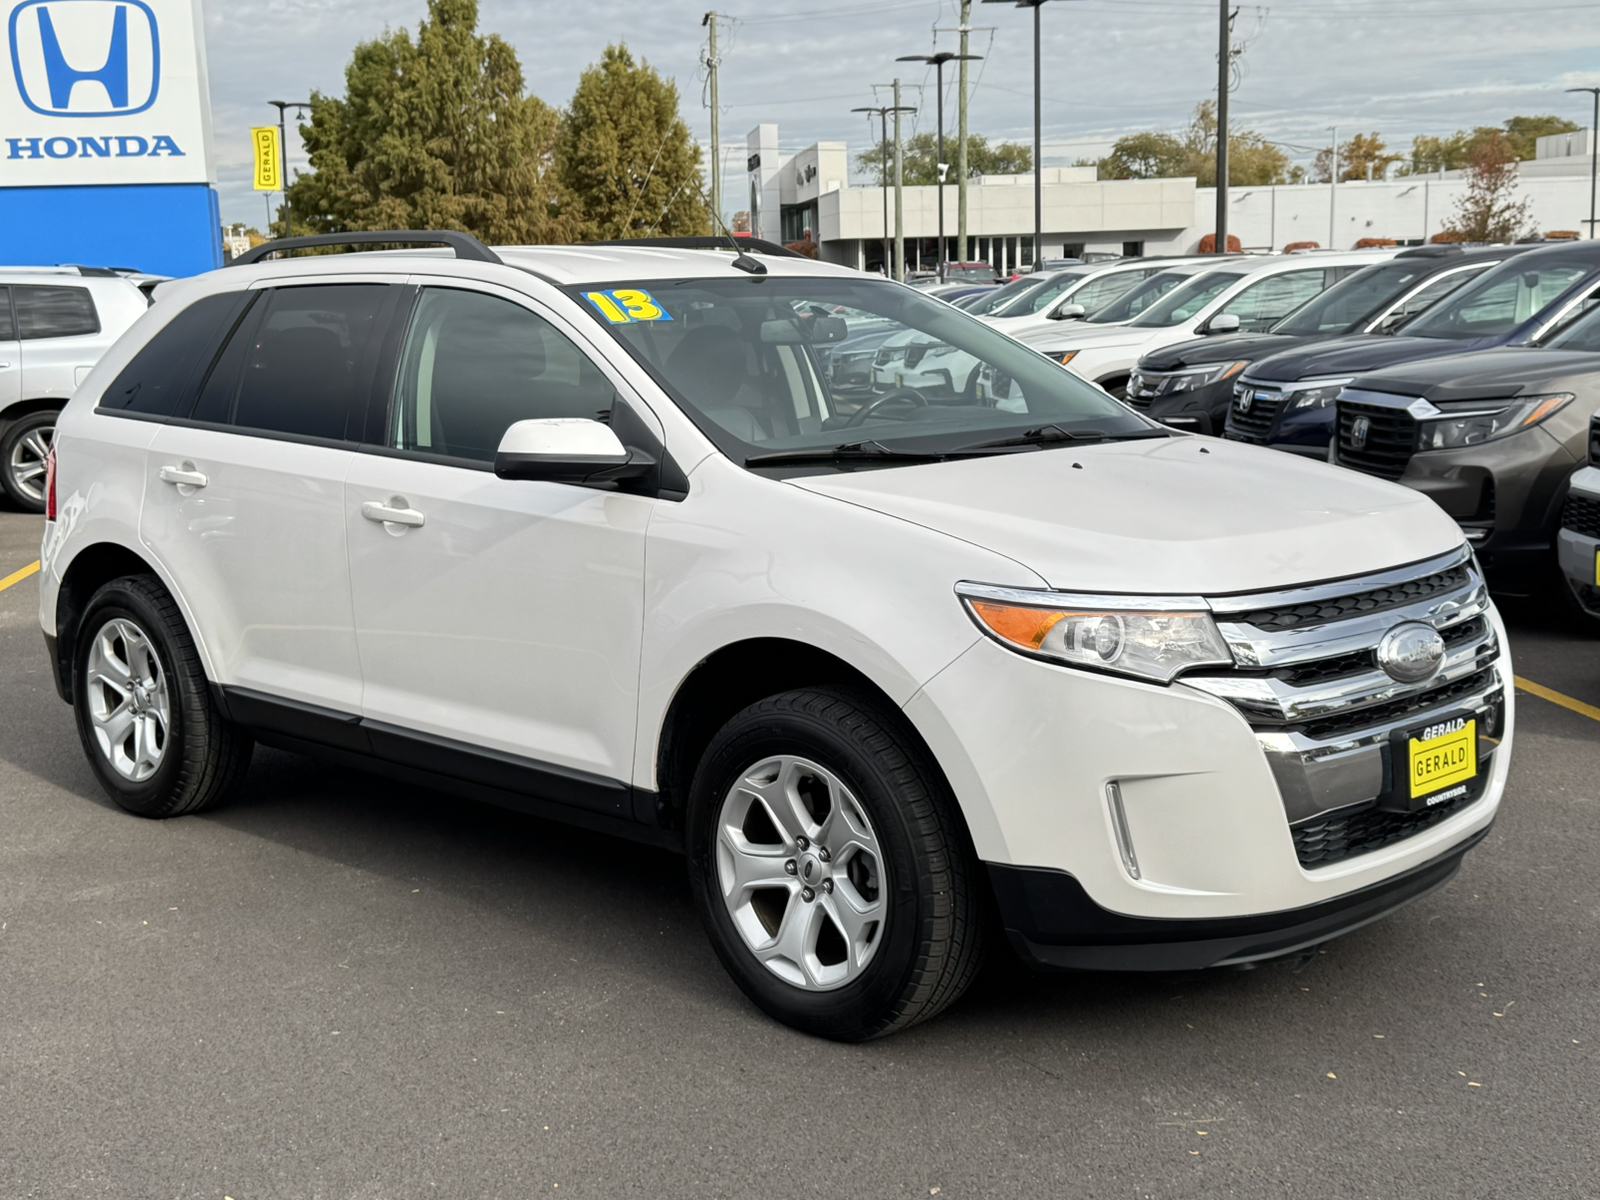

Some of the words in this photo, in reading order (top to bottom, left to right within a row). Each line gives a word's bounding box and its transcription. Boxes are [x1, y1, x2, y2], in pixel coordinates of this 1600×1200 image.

[5, 135, 186, 159] HONDA
[262, 135, 271, 182] GERALD
[587, 289, 662, 323] 13
[1423, 718, 1465, 740] GERALD
[1416, 747, 1466, 777] GERALD
[1426, 785, 1467, 806] COUNTRYSIDE
